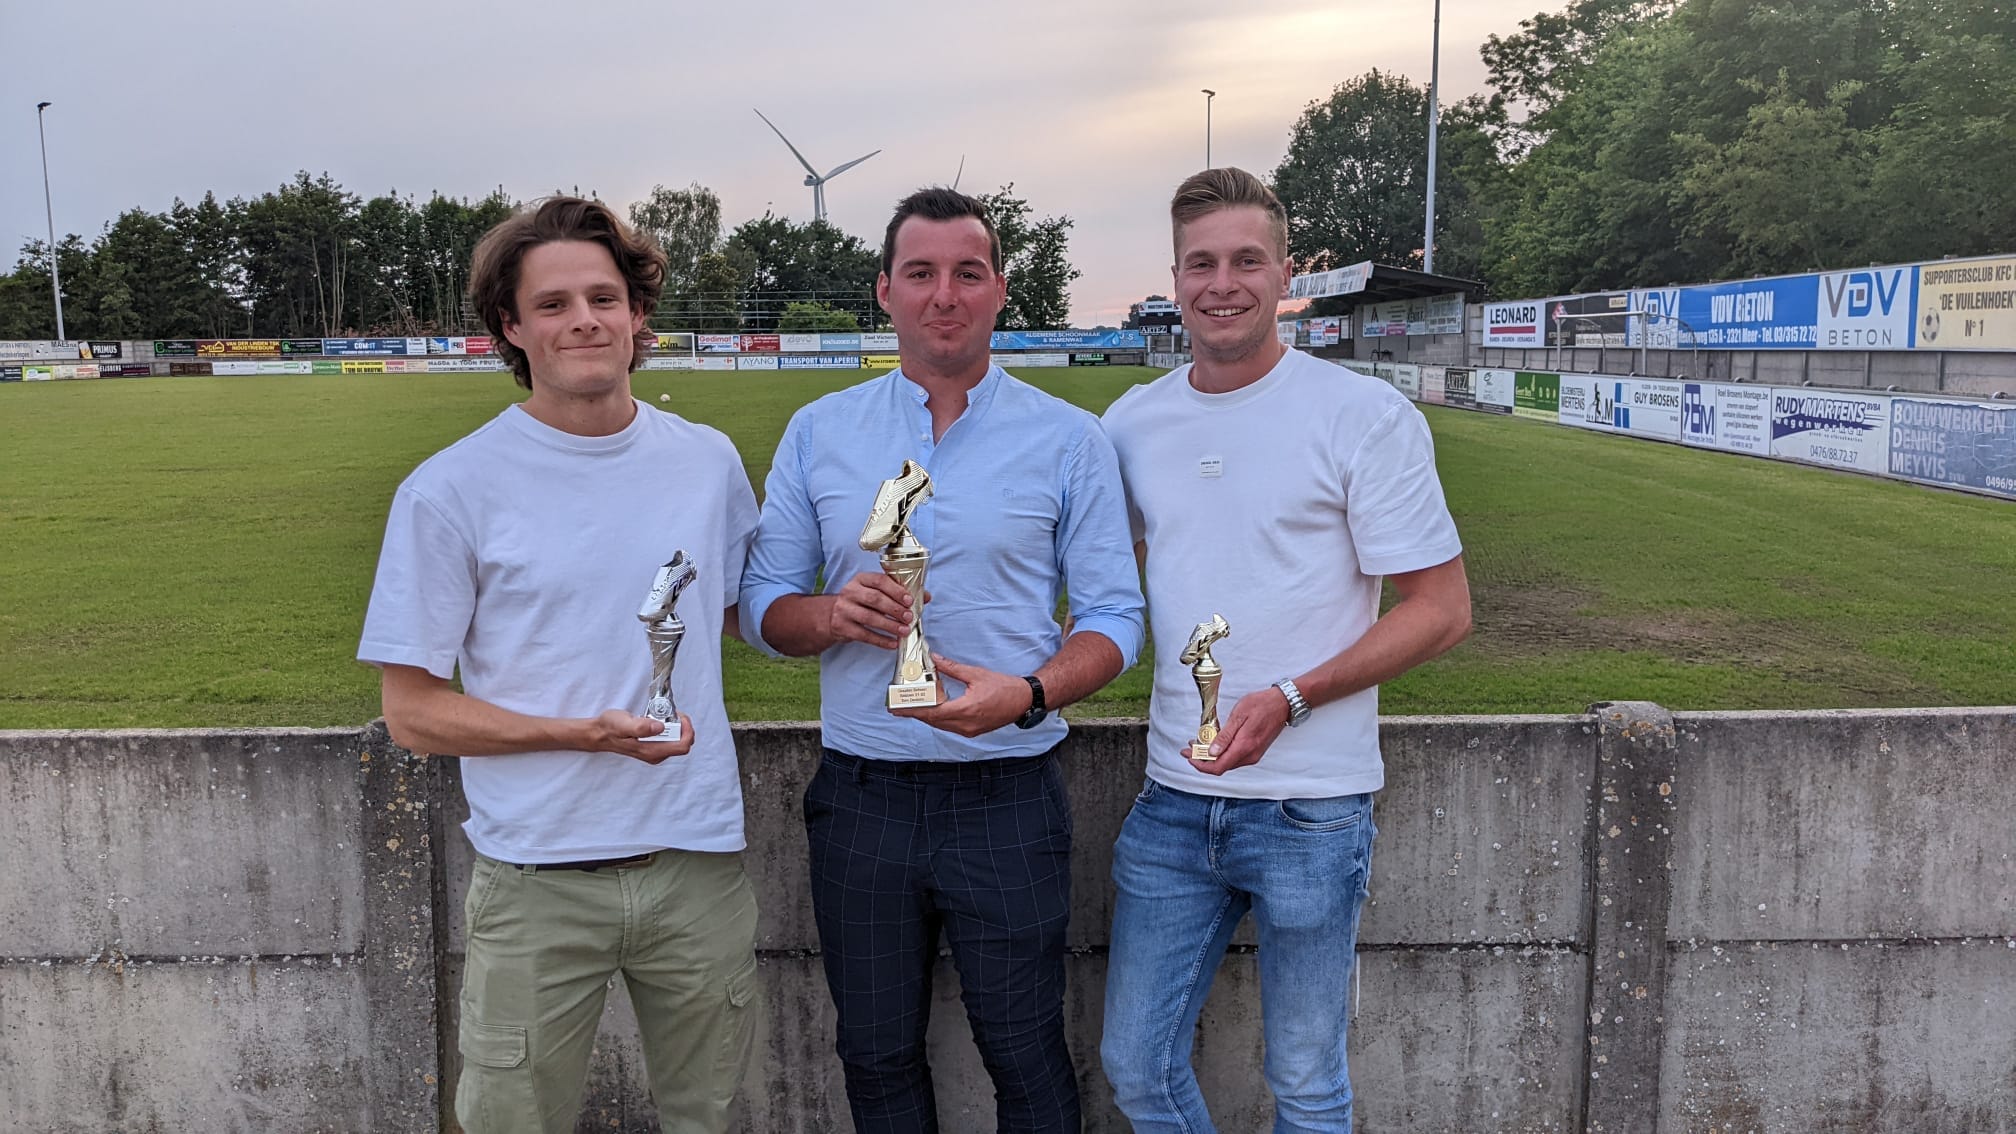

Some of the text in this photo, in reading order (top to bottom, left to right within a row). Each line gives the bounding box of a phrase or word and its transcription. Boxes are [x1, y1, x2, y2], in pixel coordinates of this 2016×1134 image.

[1923, 266, 1993, 286] SUPPORTERSCLUB
[1995, 265, 2012, 281] KFC
[1825, 269, 1903, 318] VDV
[1490, 306, 1536, 324] LEONARD
[1711, 291, 1774, 324] VDV BETON
[1726, 328, 1741, 343] 2321
[1774, 326, 1798, 343] 03/315
[1799, 326, 1807, 342] 72
[1808, 325, 1817, 342] 72
[1828, 328, 1892, 346] BETON
[1979, 319, 1984, 337] 1
[92, 344, 118, 354] PRIMUS
[780, 356, 859, 364] TRANSPORT VAN APEREN
[1561, 396, 1585, 410] MERTENS
[1634, 391, 1679, 408] GUY BROSENS
[1775, 396, 1805, 415] RUDY
[1804, 397, 1866, 424] MARTENS
[1894, 403, 2006, 434] BOUWWERKEN
[1775, 416, 1863, 436] wegenwerken
[1892, 427, 1946, 454] DENNIS
[1891, 452, 1946, 479] MEYVIS
